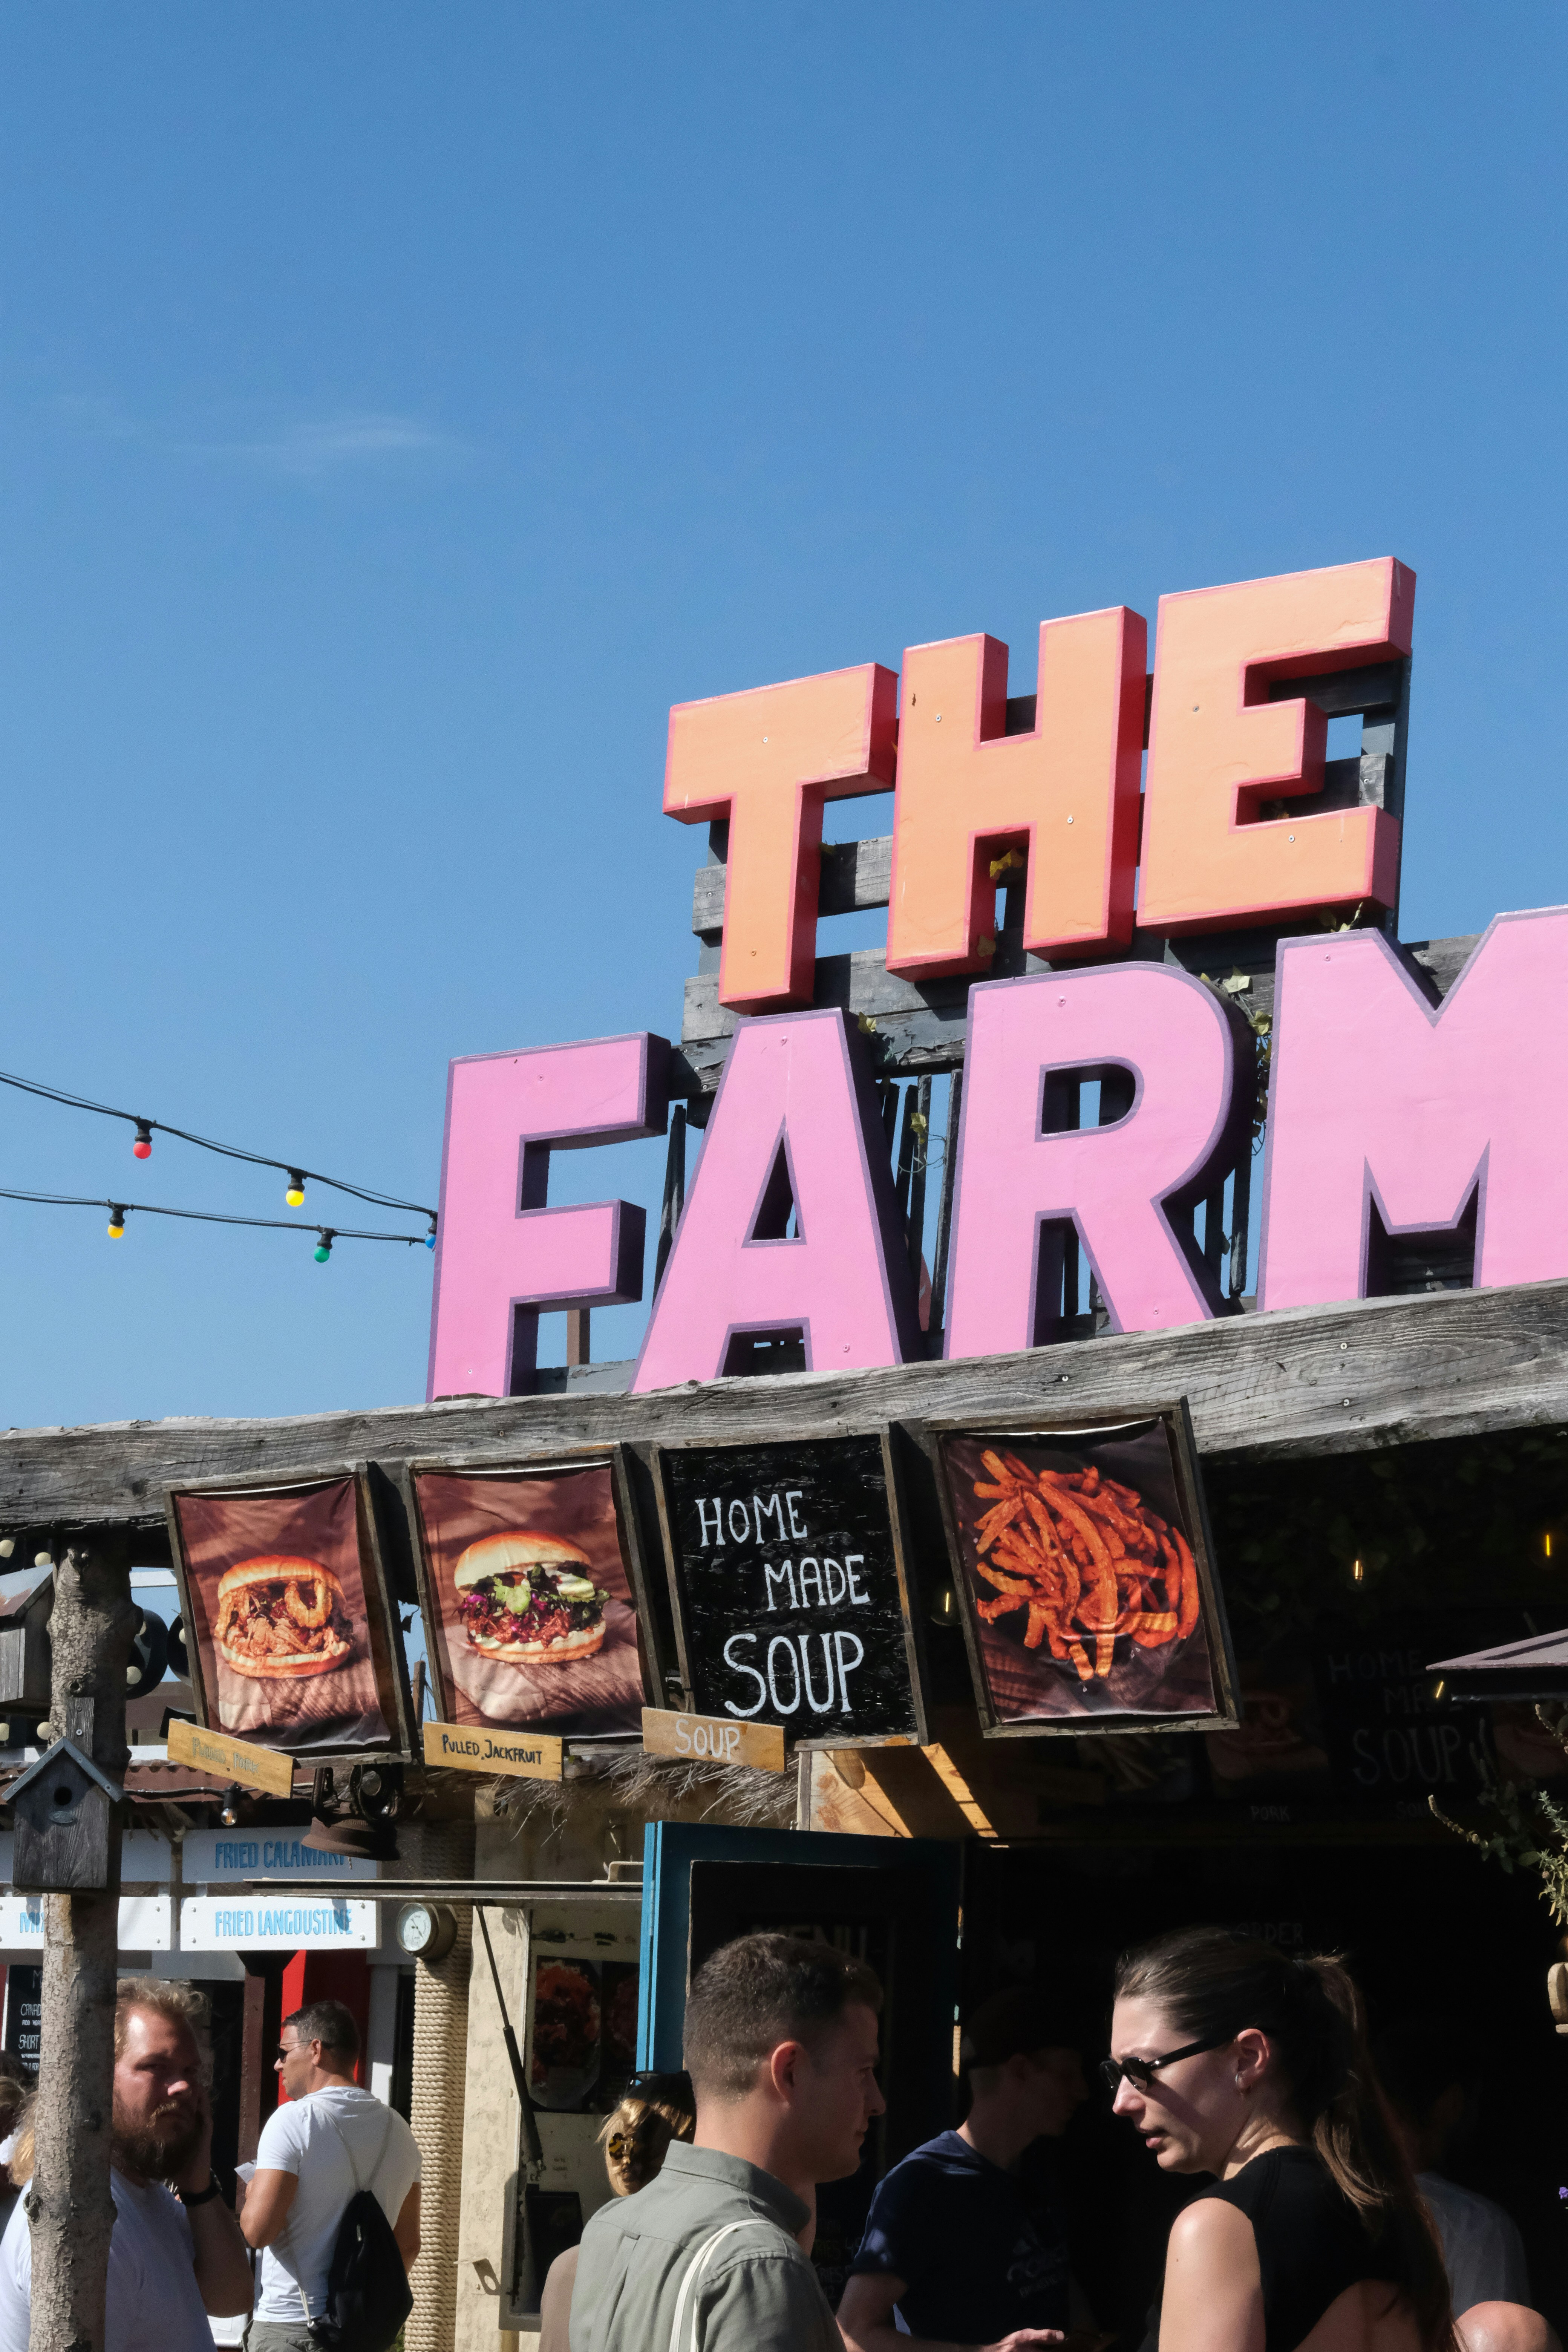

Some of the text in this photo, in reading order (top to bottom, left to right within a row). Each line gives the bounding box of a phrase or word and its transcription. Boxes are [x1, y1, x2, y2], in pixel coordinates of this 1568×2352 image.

[662, 556, 1416, 1015] THE
[428, 905, 1568, 1405] FARM
[695, 1491, 807, 1547] HOME
[764, 1554, 870, 1611] MADE
[723, 1631, 864, 1717] SOUP
[1327, 1649, 1426, 1684] HOME
[192, 1736, 259, 1774] PULLED PORK
[442, 1733, 543, 1765] PULLED JACKFRUIT
[675, 1718, 740, 1761] SOUP
[1352, 1725, 1461, 1785] SOUP
[1250, 1805, 1291, 1822] PORK
[1395, 1801, 1429, 1819] SOU
[215, 1842, 259, 1868] FRIED
[215, 1908, 353, 1937] FRIED LANGOUSTINE
[18, 2034, 40, 2049] SHORT
